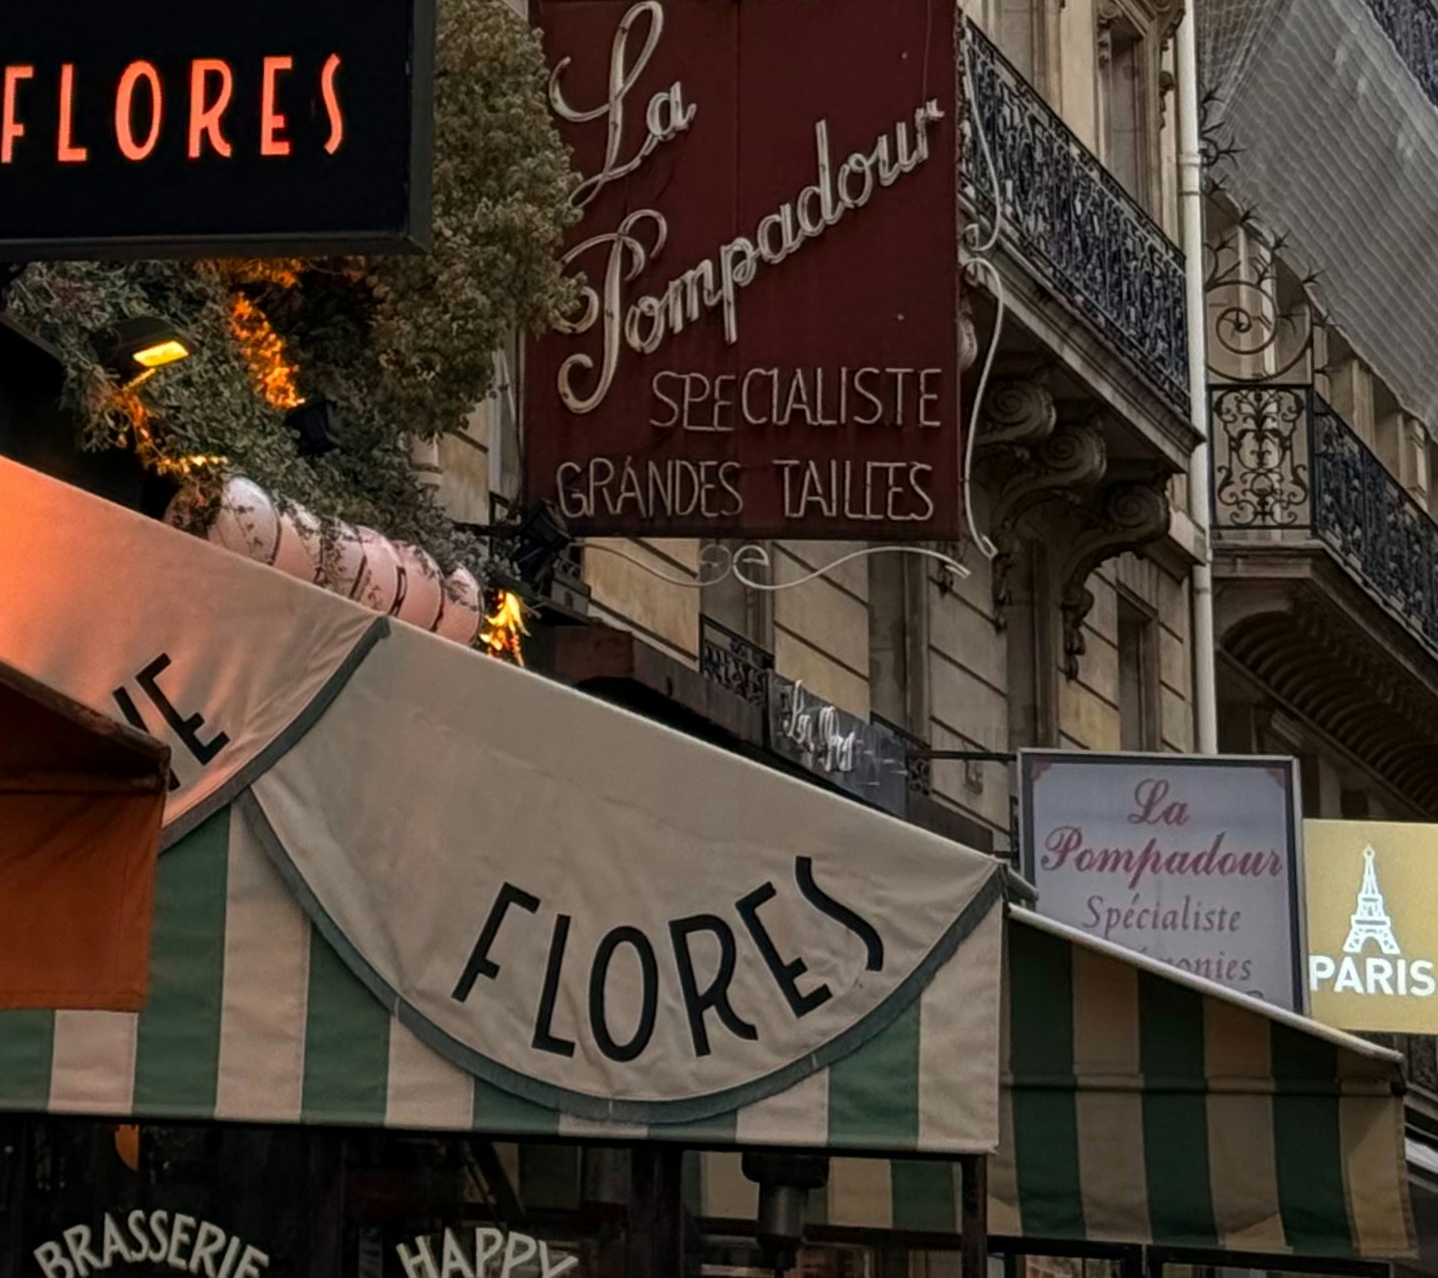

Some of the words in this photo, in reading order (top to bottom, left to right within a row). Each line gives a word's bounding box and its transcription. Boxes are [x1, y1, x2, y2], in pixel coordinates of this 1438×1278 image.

[0, 52, 344, 164] FLORES
[548, 0, 697, 208] La
[554, 99, 946, 414] Pompadour
[650, 366, 943, 432] SPECIALISTE
[556, 456, 744, 519] GRANDES
[772, 458, 934, 521] TAILLES
[1127, 778, 1191, 826] La
[1040, 825, 1284, 890] Pompadour
[1081, 893, 1242, 939] Spécialiste
[451, 855, 884, 1063] FLORES
[1308, 954, 1436, 997] PARIS
[34, 1208, 269, 1278] BRASSERIE
[396, 1226, 579, 1278] HAPPY
